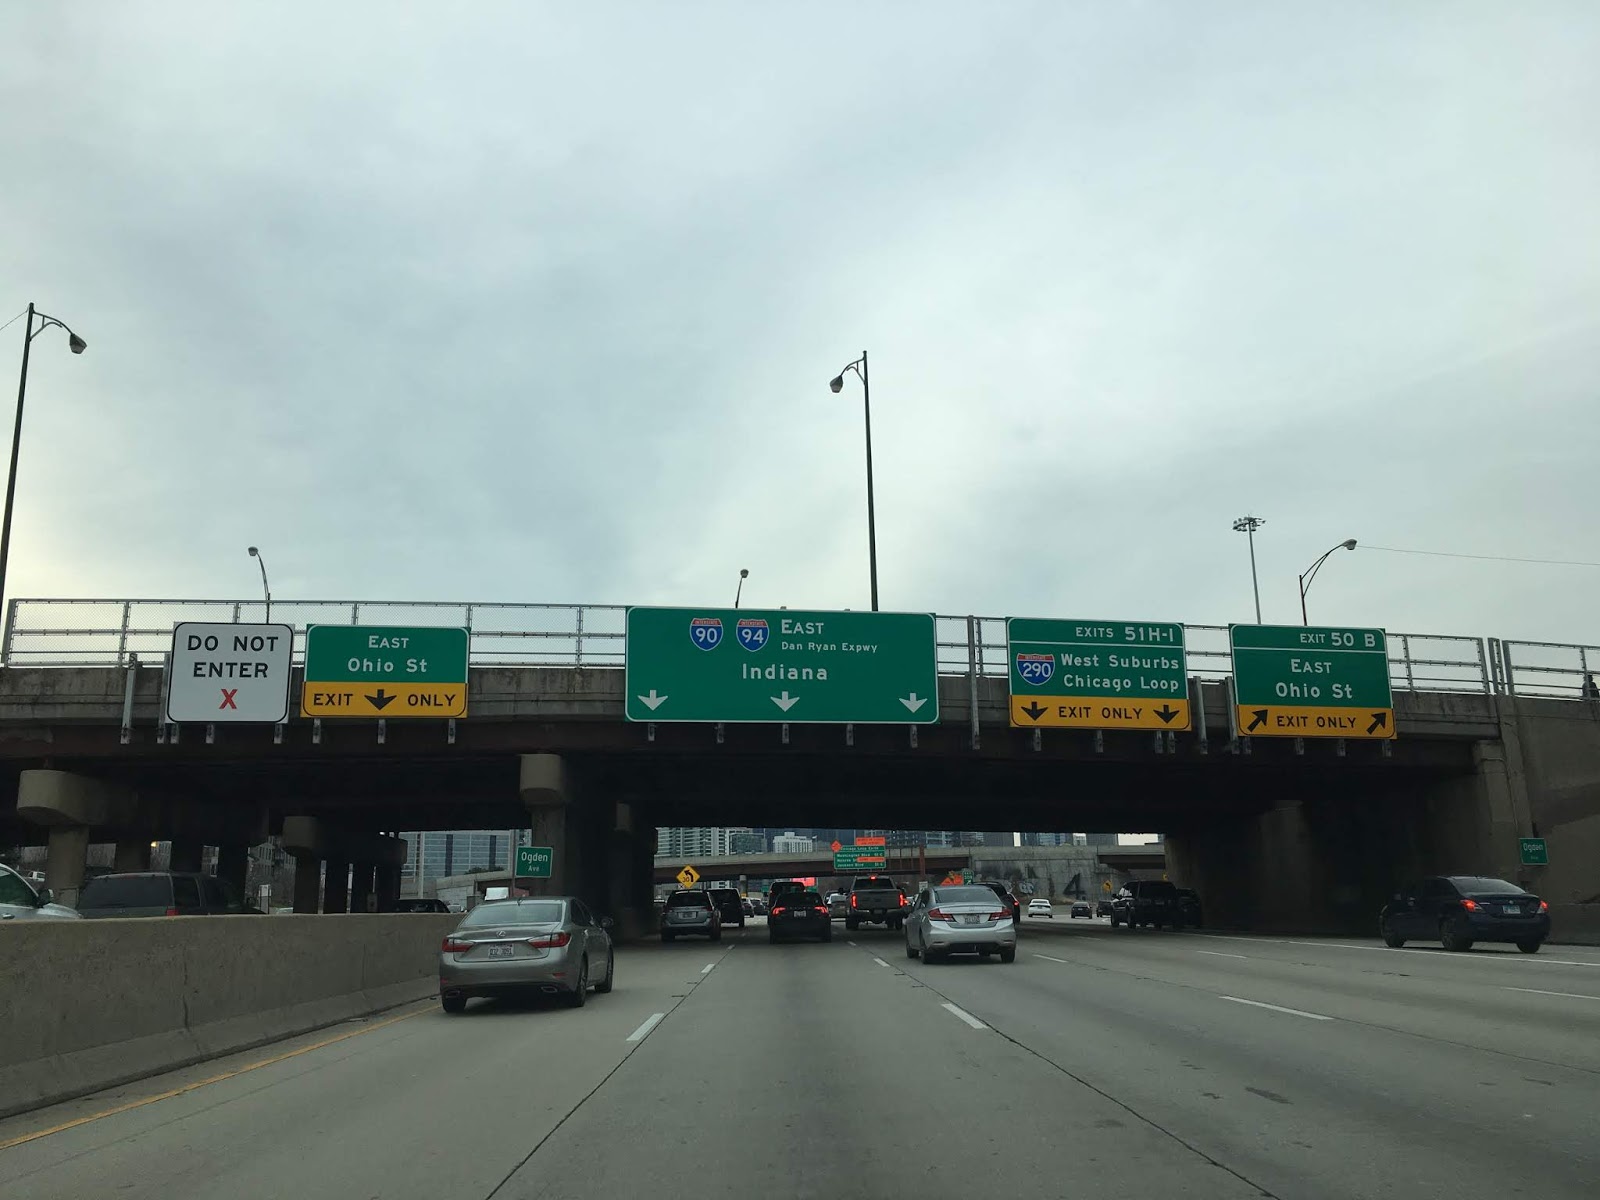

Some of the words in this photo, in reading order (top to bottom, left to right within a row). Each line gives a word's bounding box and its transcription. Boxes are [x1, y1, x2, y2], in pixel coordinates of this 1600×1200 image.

[781, 619, 824, 635] EAST
[1075, 627, 1114, 638] EXITS
[187, 635, 219, 651] DO
[233, 635, 279, 652] NOT
[368, 635, 409, 649] EAST
[695, 628, 718, 643] 90
[741, 628, 764, 644] 94
[1300, 633, 1325, 644] EXIT
[1331, 632, 1354, 647] 50
[1364, 633, 1376, 647] B
[781, 641, 803, 651] Dan
[808, 642, 837, 653] Ryan
[841, 643, 878, 653] Expwy
[193, 661, 269, 678] ENTER
[347, 657, 394, 672] Ohio
[406, 658, 428, 673] St
[1061, 653, 1100, 667] West
[1109, 654, 1179, 670] Suburbs
[1290, 658, 1332, 674] EAST
[742, 663, 828, 681] Indiana
[1022, 662, 1052, 678] 290
[1063, 674, 1132, 692] Chicago
[1140, 676, 1179, 693] Loop
[1275, 682, 1321, 698] Ohio
[1331, 683, 1353, 699] St
[313, 693, 353, 706] EXIT
[407, 694, 456, 707] ONLY
[1058, 706, 1091, 719] EXIT
[1101, 707, 1143, 720] ONLY
[1276, 715, 1308, 728] EXIT
[1316, 716, 1357, 729] ONLY
[521, 851, 549, 864] Ogden
